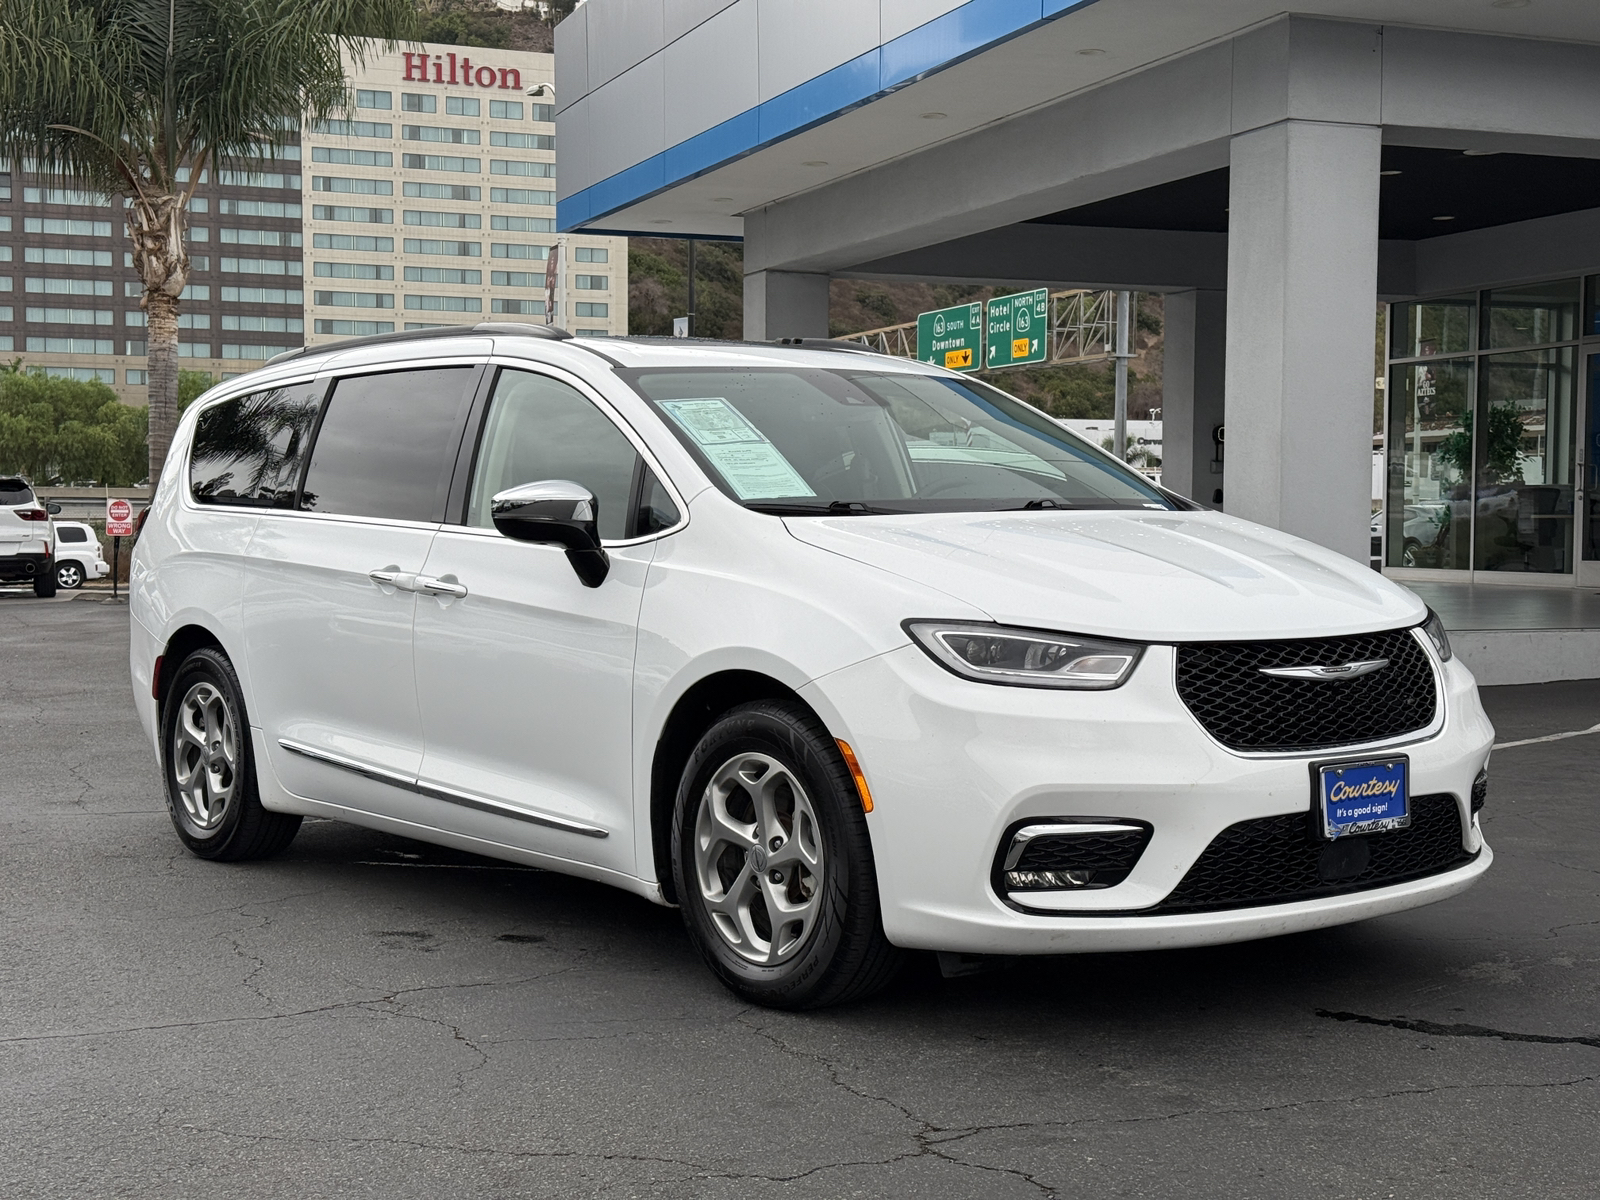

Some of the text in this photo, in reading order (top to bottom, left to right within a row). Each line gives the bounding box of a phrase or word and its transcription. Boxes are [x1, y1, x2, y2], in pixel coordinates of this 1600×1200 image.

[402, 52, 523, 90] Hilton
[1014, 295, 1033, 308] NORTH
[1036, 292, 1046, 301] EXIT
[971, 306, 980, 315] EXIT
[990, 303, 1010, 318] Hotel
[1036, 302, 1046, 313] 4B
[946, 320, 964, 332] SOUTH
[971, 315, 980, 325] 4A
[1018, 316, 1029, 329] 163
[935, 322, 945, 334] 163
[989, 321, 1010, 334] Circle
[932, 337, 965, 352] Downtown
[1014, 342, 1028, 354] ONLY
[946, 355, 959, 366] ONLY
[1422, 380, 1430, 388] GO
[1417, 387, 1436, 397] AZTECS
[1330, 776, 1400, 802] Courtesy
[1336, 807, 1347, 818] It's
[1353, 803, 1371, 818] good
[1372, 802, 1388, 815] sign!
[1348, 818, 1390, 835] Courtesy
